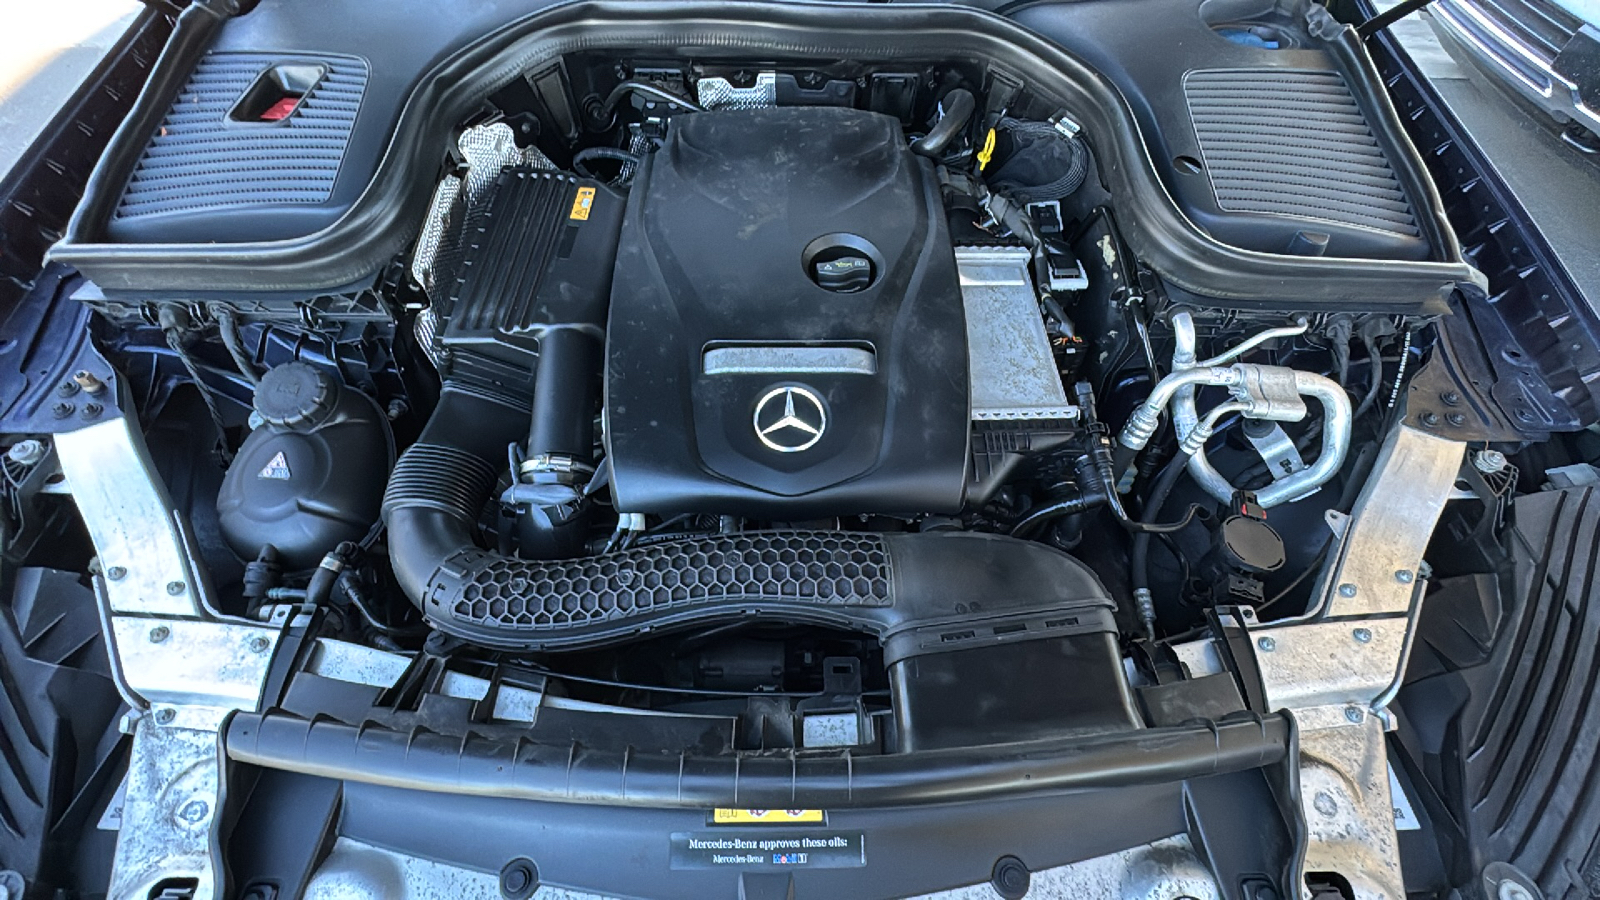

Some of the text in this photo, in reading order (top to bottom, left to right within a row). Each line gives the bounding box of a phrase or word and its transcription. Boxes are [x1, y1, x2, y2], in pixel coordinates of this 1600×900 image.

[689, 836, 848, 851] Mercedes-Benz approves these oils:
[713, 854, 764, 864] Mercedes-Benz
